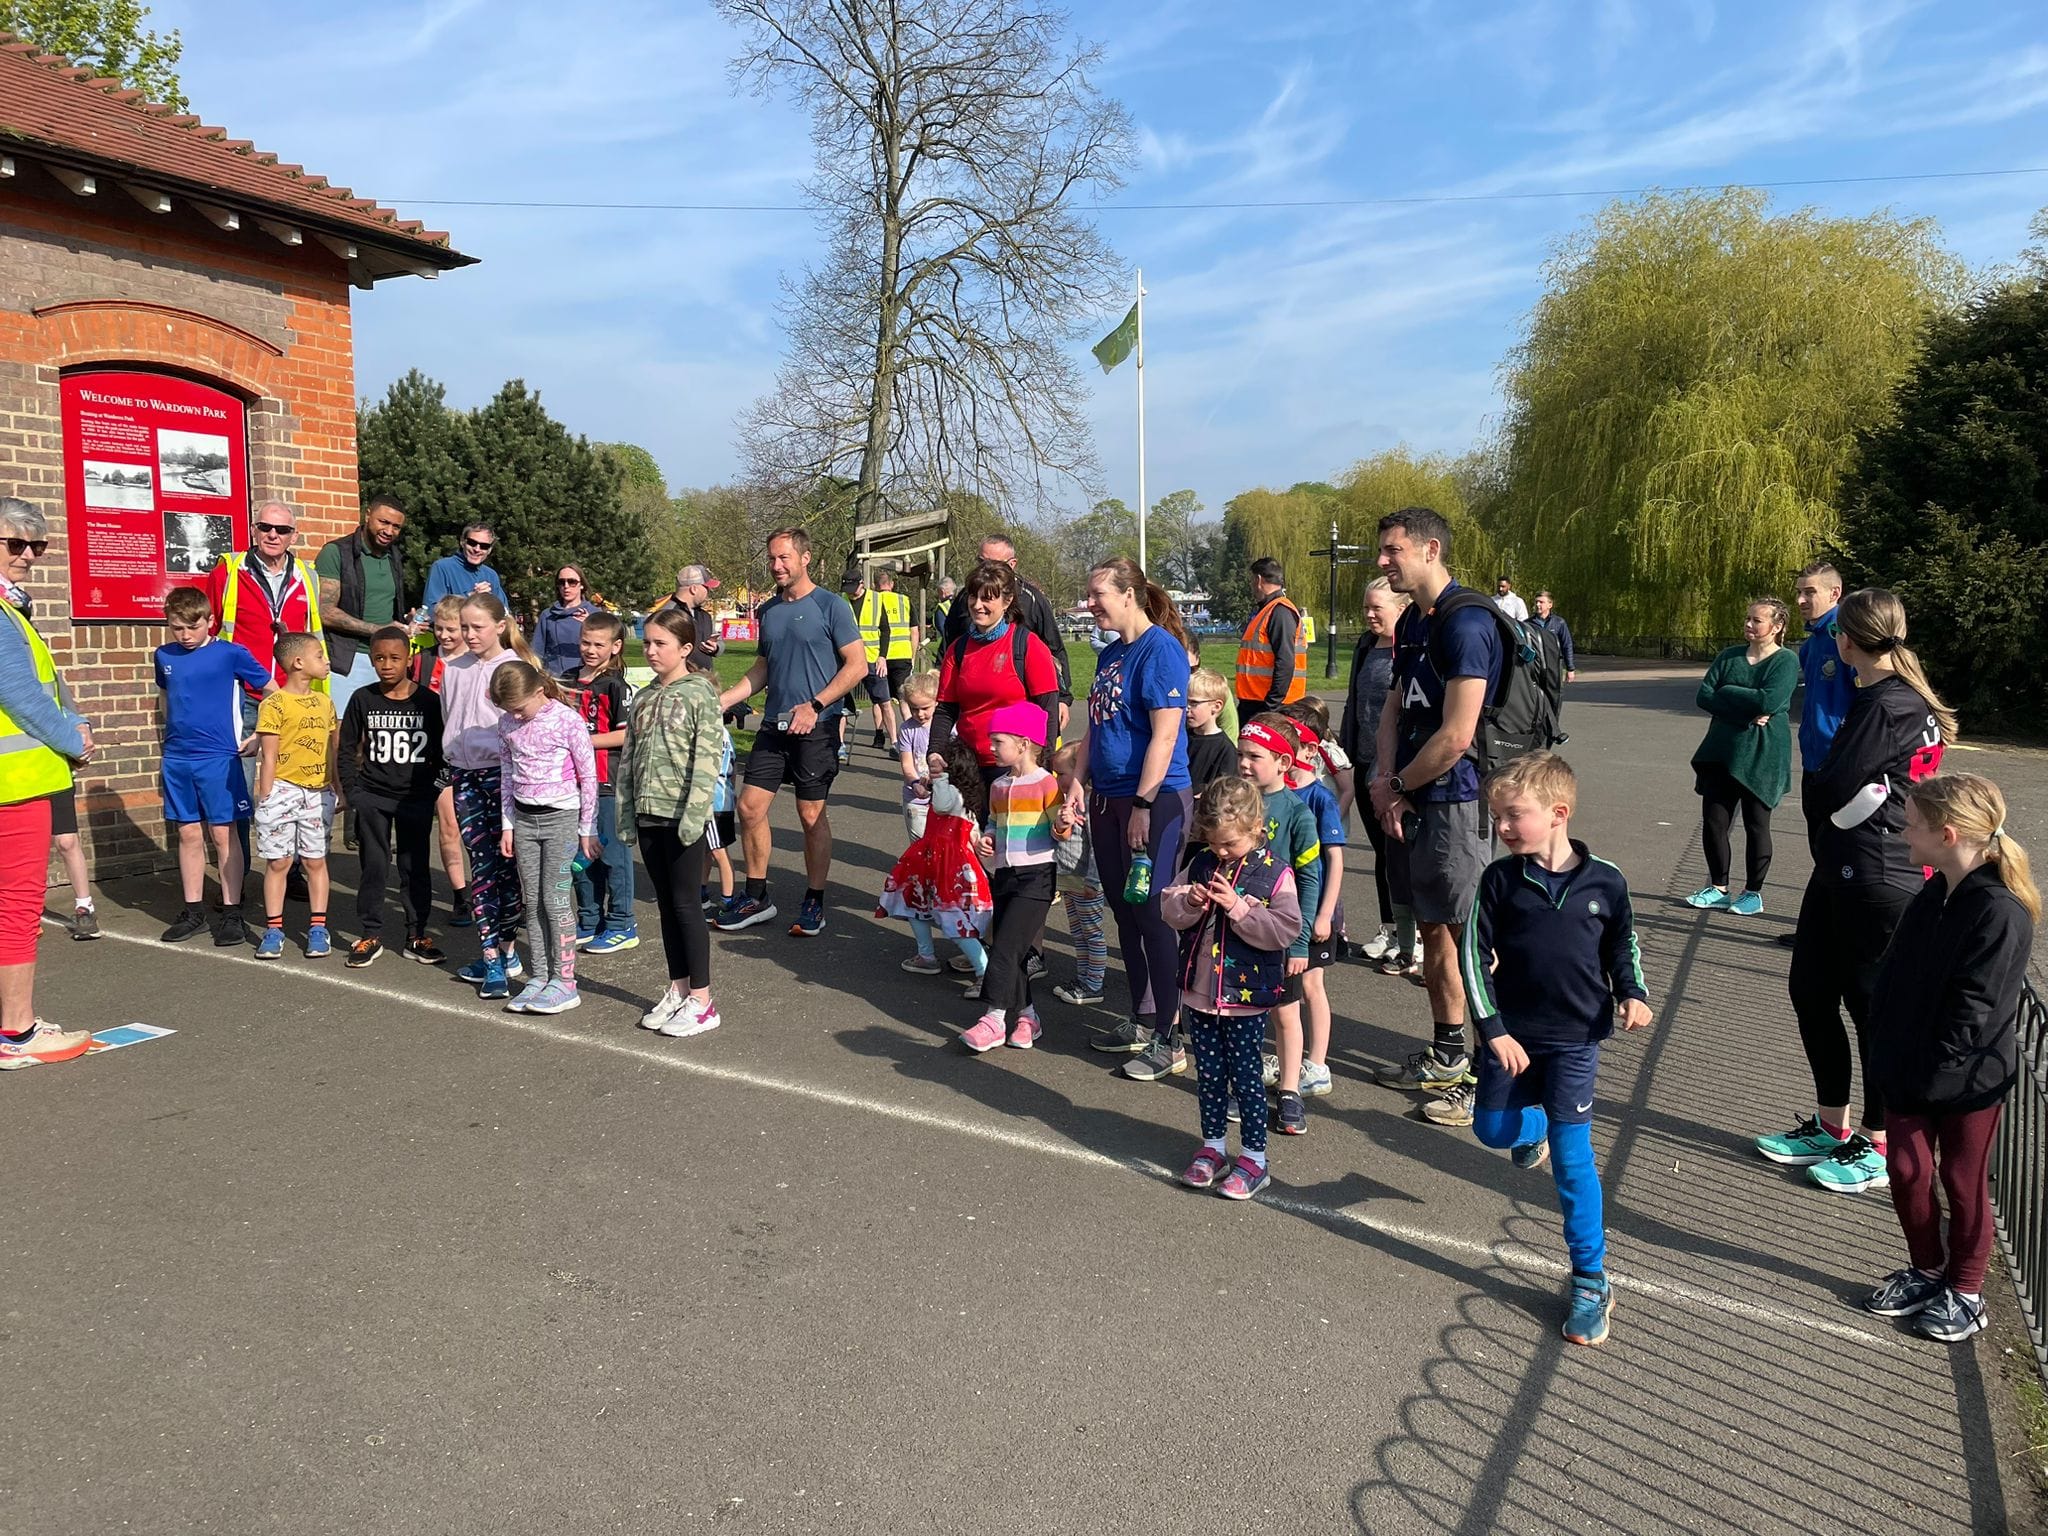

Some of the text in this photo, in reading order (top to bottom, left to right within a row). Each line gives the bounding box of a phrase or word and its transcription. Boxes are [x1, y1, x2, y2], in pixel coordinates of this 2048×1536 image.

[80, 389, 134, 407] WELCOME
[149, 398, 202, 416] WARDOWN
[203, 406, 228, 420] PARK
[367, 715, 424, 730] BROOKLYN
[368, 730, 428, 765] 1962
